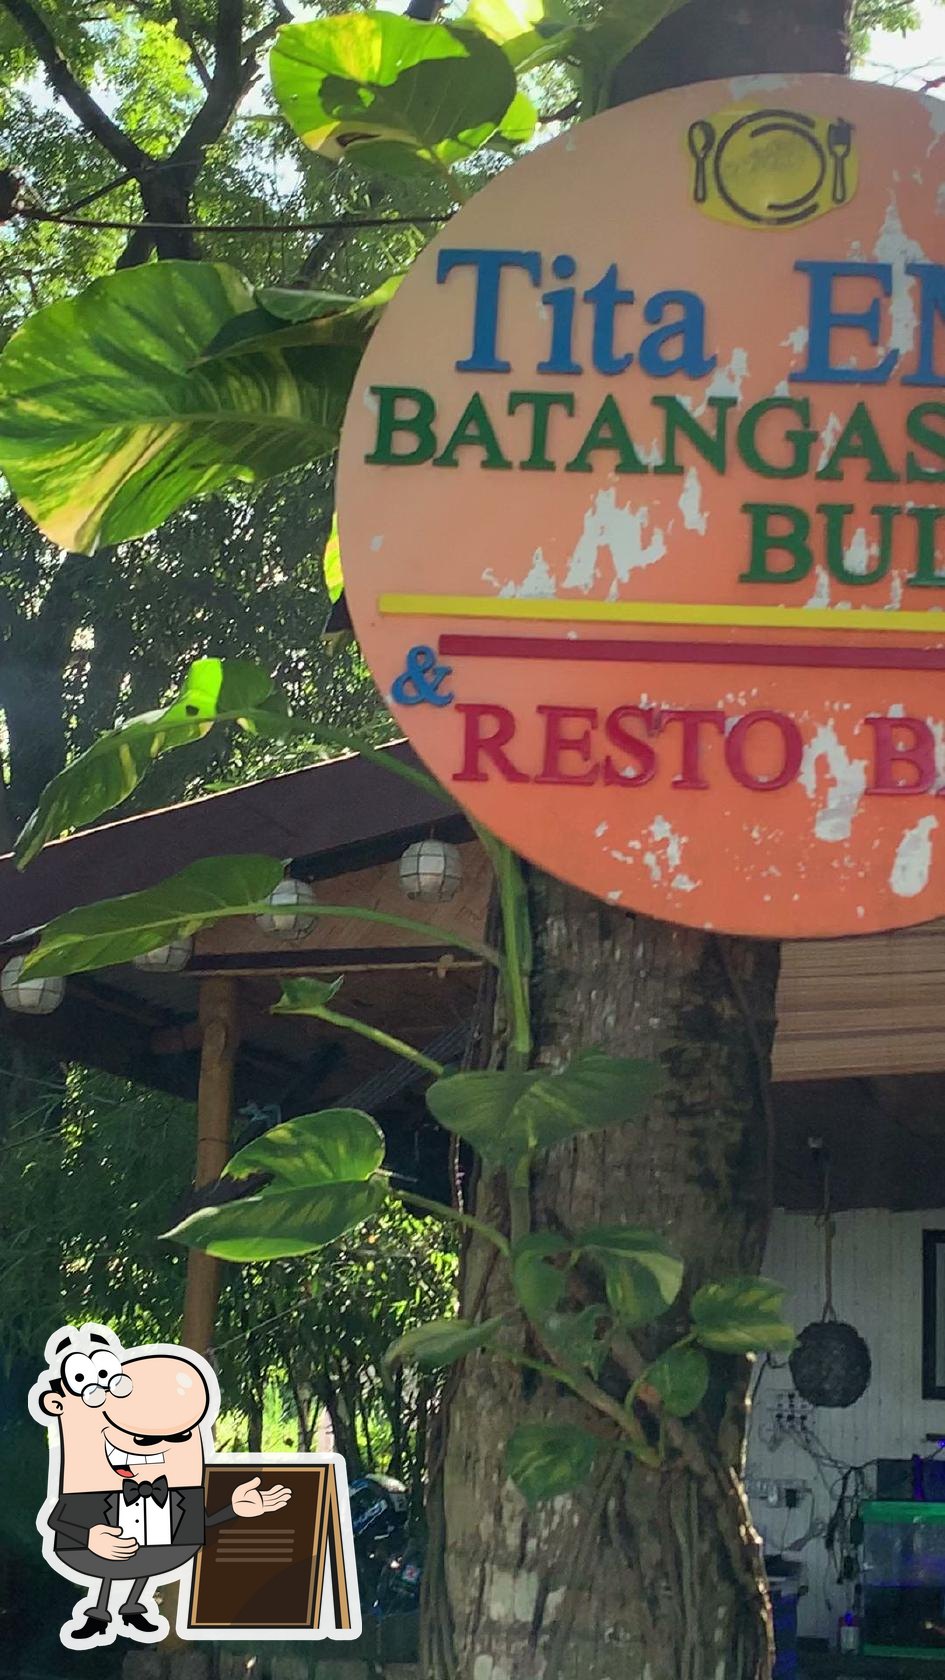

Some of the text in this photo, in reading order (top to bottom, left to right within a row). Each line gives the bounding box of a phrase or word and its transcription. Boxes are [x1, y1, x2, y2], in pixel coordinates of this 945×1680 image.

[436, 248, 717, 378] Tita
[364, 386, 945, 482] BATANGAS
[391, 645, 454, 706] &
[452, 703, 945, 797] RESTO B
